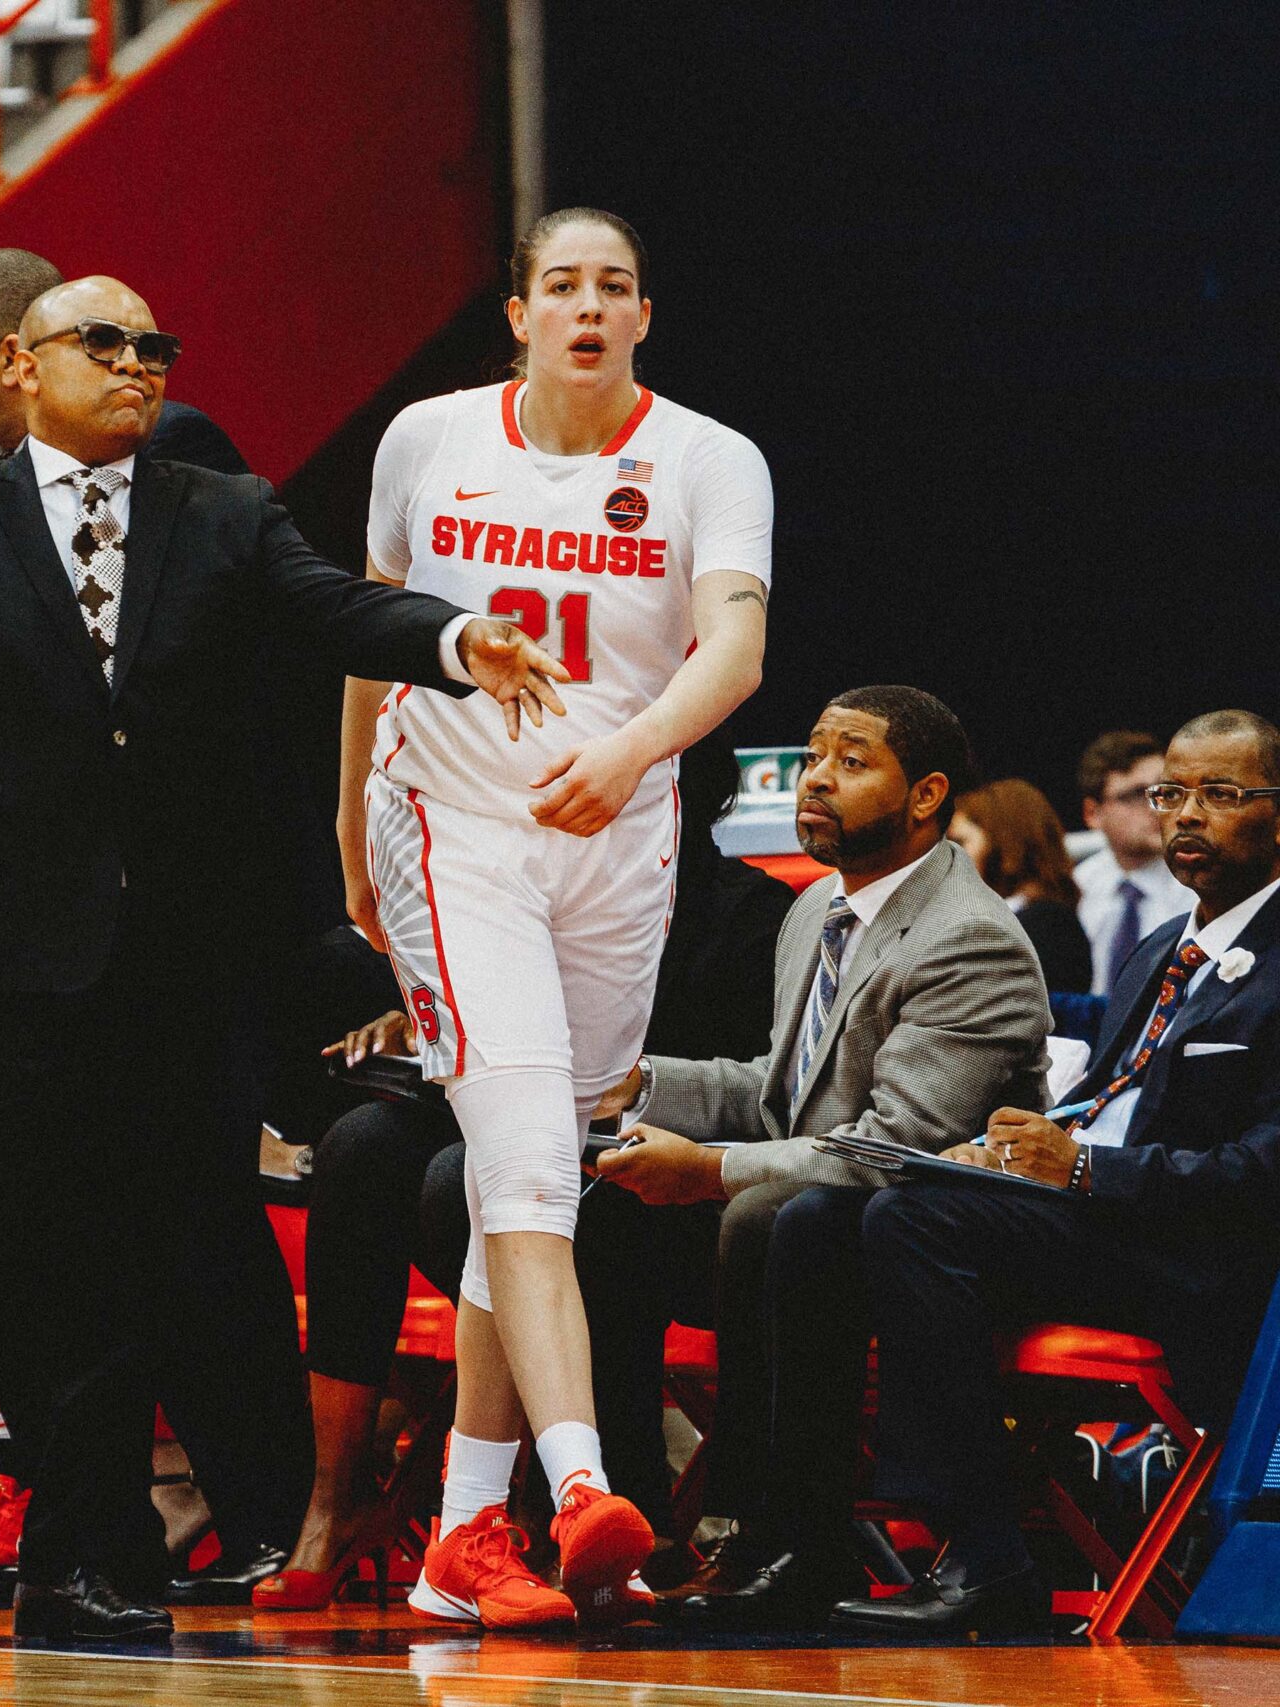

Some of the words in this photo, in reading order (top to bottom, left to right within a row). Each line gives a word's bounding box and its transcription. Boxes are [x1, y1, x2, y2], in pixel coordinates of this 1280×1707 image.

[609, 500, 648, 513] ACC
[431, 515, 667, 578] SYRACUSE
[411, 983, 441, 1046] S
